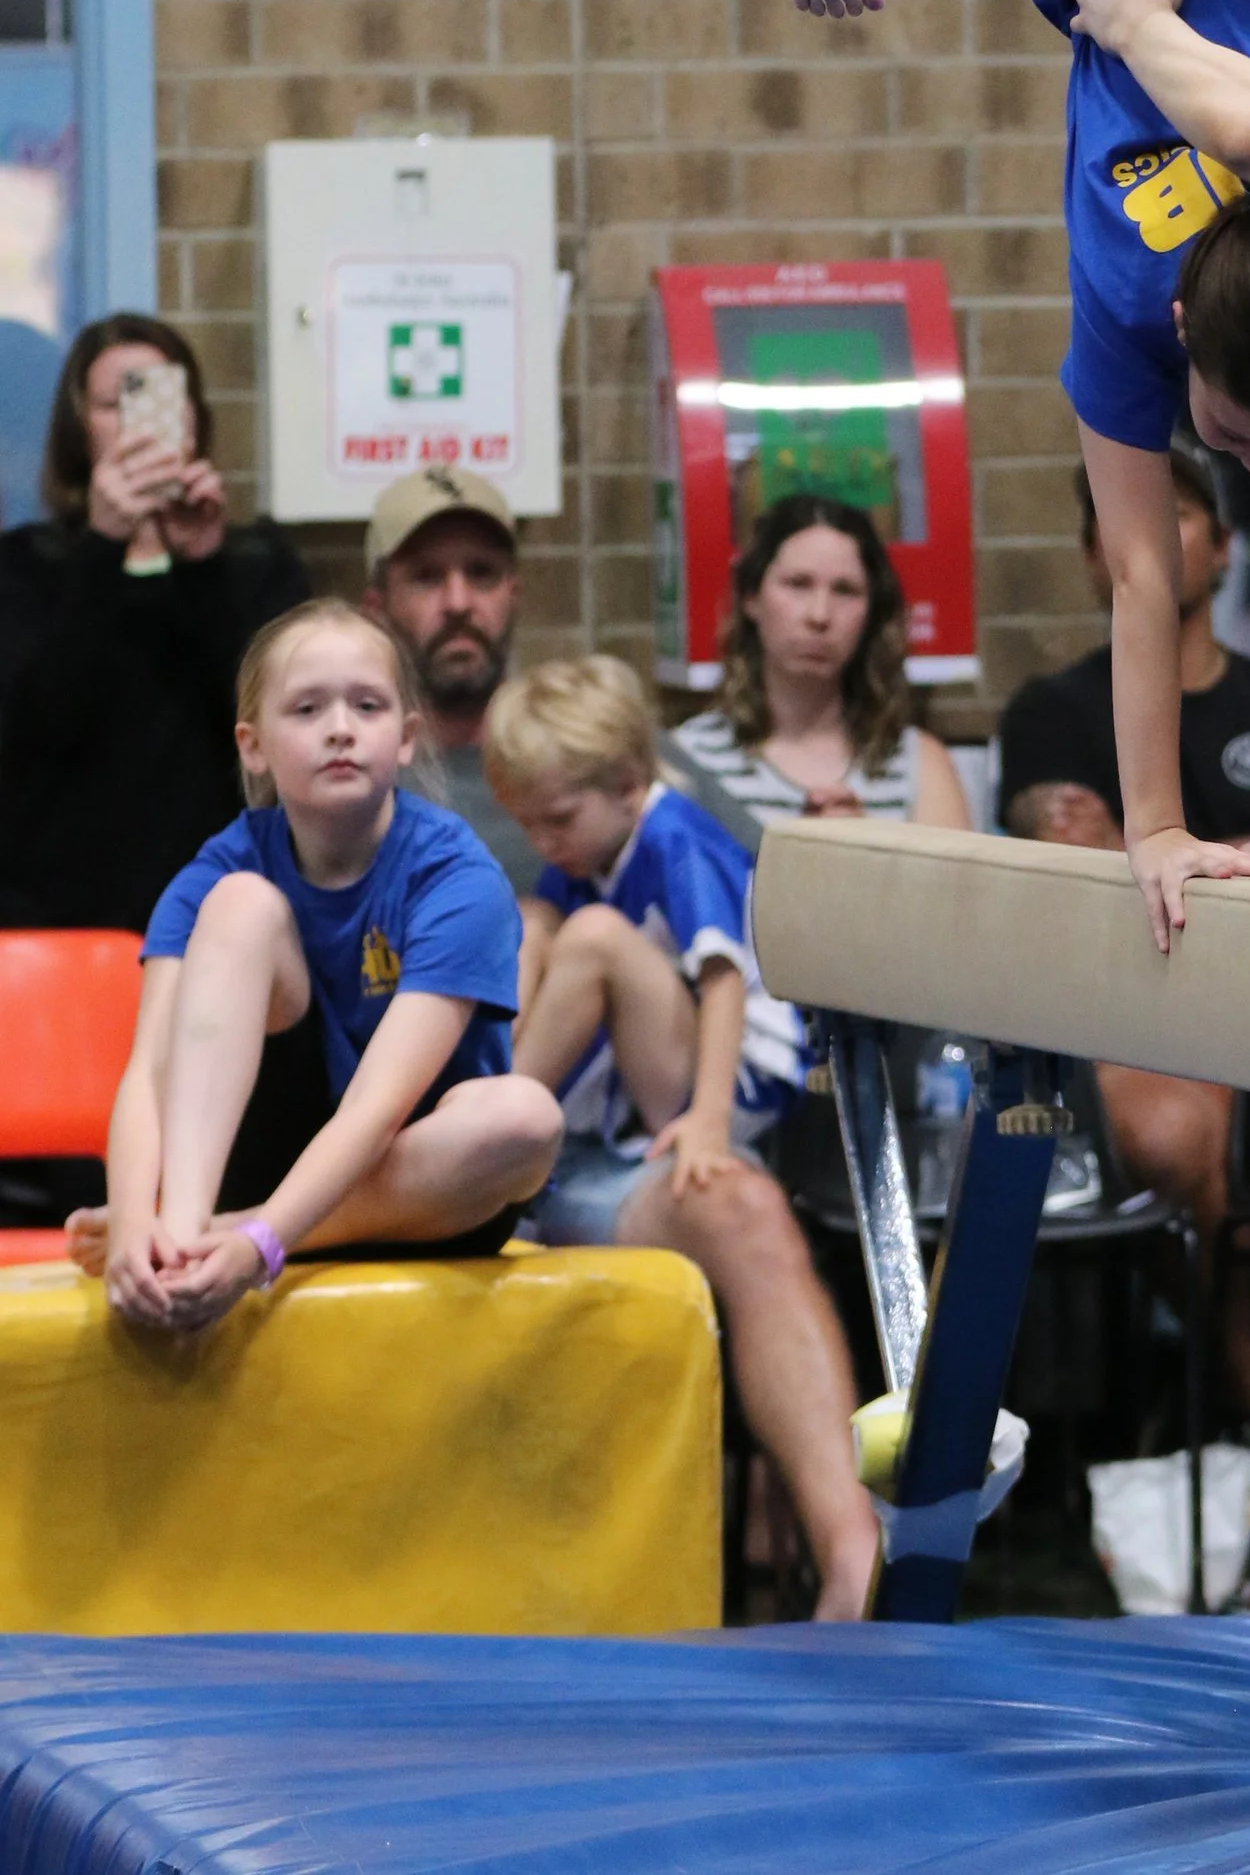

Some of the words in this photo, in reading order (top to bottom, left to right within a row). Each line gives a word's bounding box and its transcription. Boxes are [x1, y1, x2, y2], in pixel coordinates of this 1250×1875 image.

[345, 435, 407, 461] FIRST
[421, 435, 460, 462] AID
[471, 435, 508, 461] KIT
